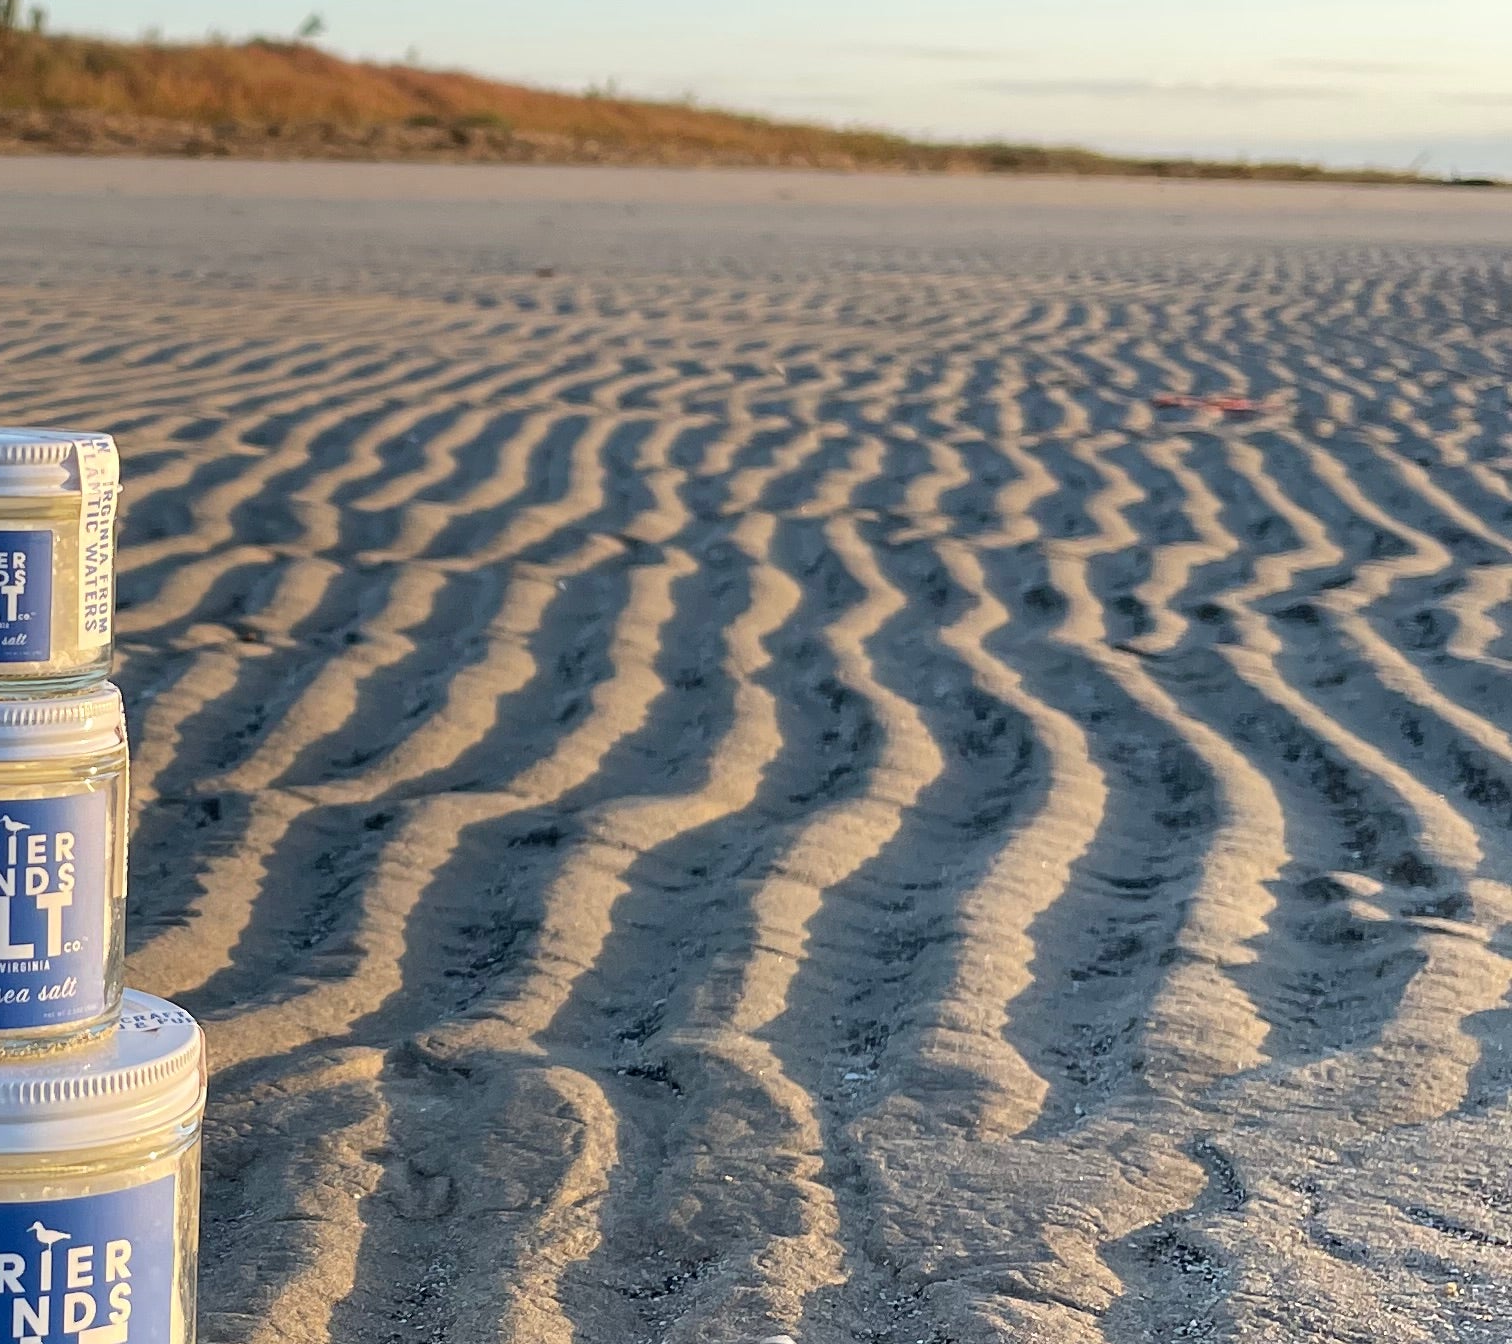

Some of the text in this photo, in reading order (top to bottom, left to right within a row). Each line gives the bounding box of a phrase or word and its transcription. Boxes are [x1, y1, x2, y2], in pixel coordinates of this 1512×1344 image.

[81, 441, 100, 632] TLANTIC WATERS
[99, 470, 114, 566] IRGINIA
[99, 574, 109, 634] FROM
[1, 633, 28, 646] salt
[0, 959, 51, 974] VIRGINIA
[37, 976, 78, 1001] salt
